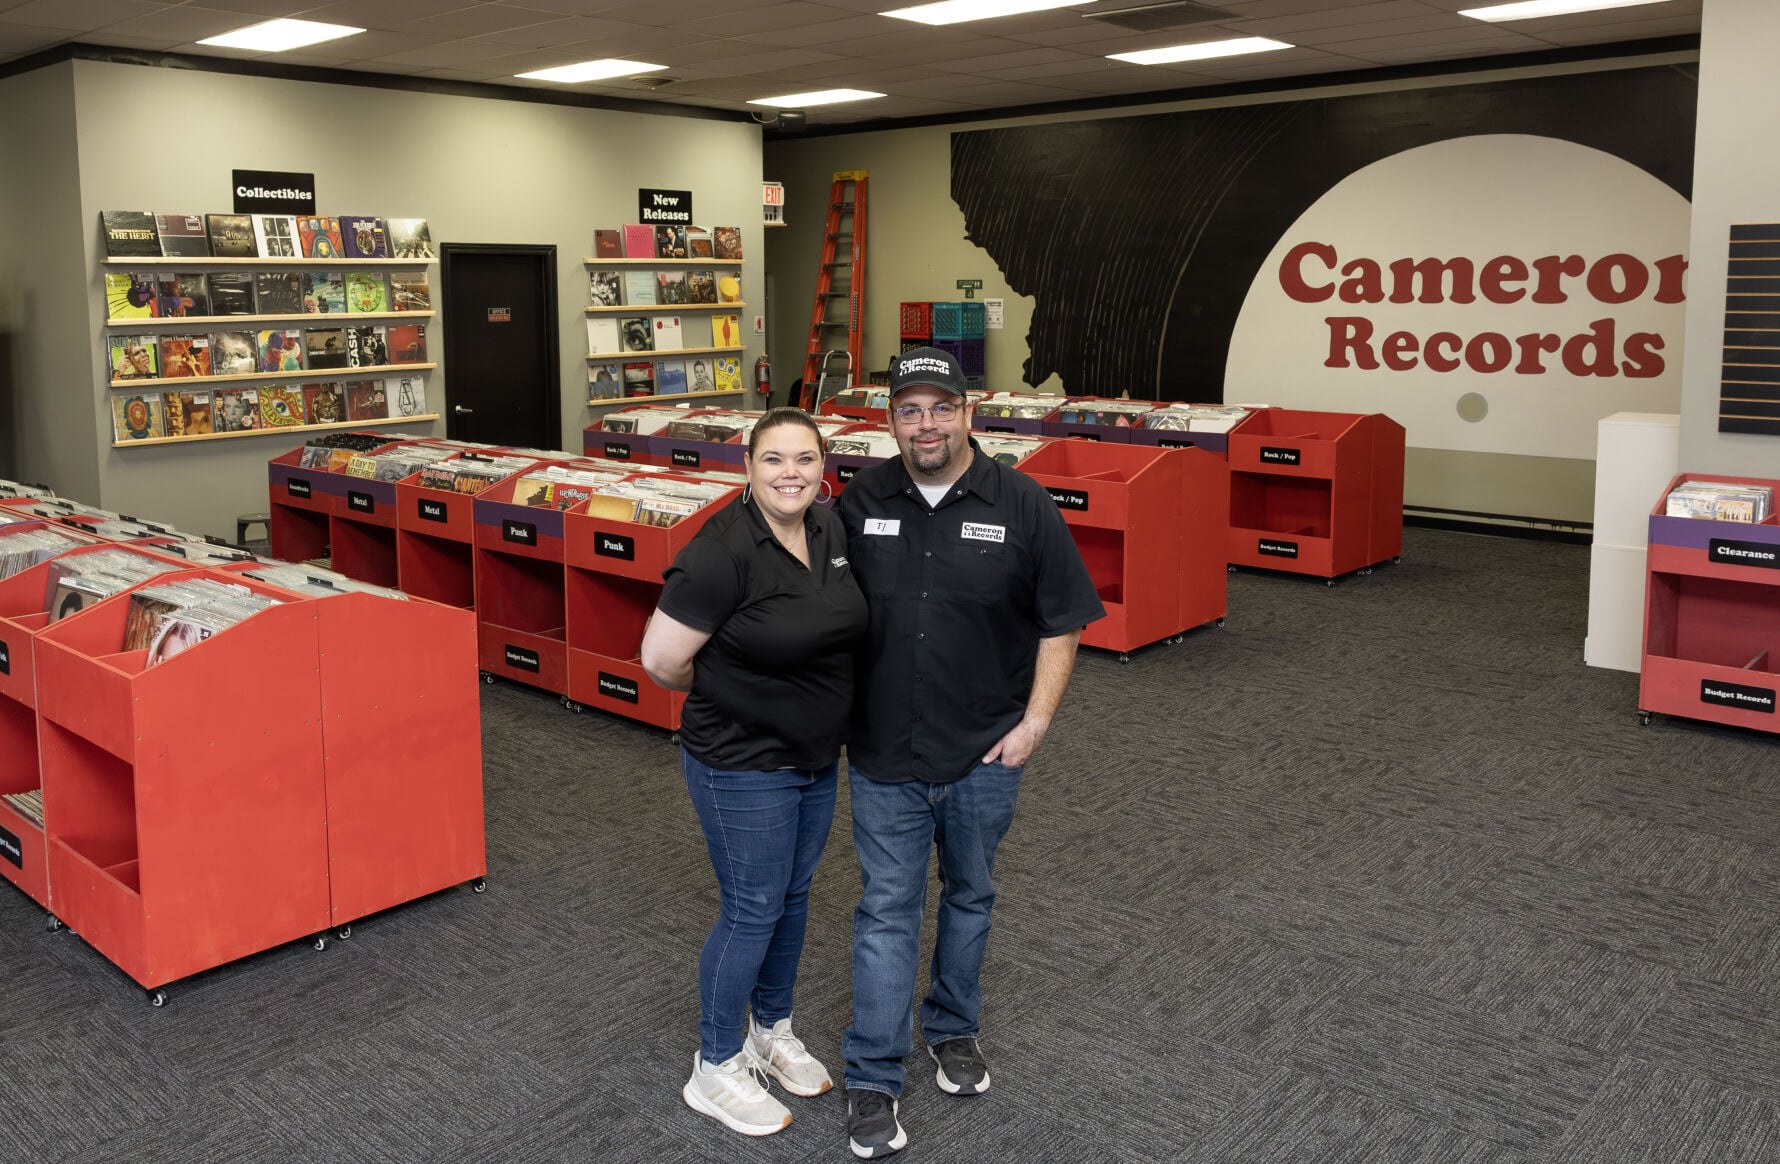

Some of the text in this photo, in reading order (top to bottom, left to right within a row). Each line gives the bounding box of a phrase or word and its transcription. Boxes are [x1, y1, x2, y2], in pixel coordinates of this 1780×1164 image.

[236, 186, 312, 200] Collectibles
[766, 186, 782, 204] EXIT
[653, 194, 679, 206] New
[643, 208, 689, 221] Releases
[109, 232, 155, 240] THE HEIST
[347, 328, 360, 368] CASH
[1323, 316, 1666, 378] Records
[899, 357, 950, 370] Cameron
[908, 365, 950, 376] Records
[353, 496, 368, 507] Metal
[1050, 494, 1065, 502] ock
[1070, 496, 1084, 504] Pop
[424, 504, 440, 516] Metal
[510, 526, 528, 538] Punk
[963, 524, 1003, 535] Cameron
[971, 531, 1003, 541] Records
[603, 540, 624, 552] Punk
[1717, 546, 1775, 560] Clearance
[600, 679, 636, 695] Budget Records
[1704, 688, 1771, 704] Budget Records
